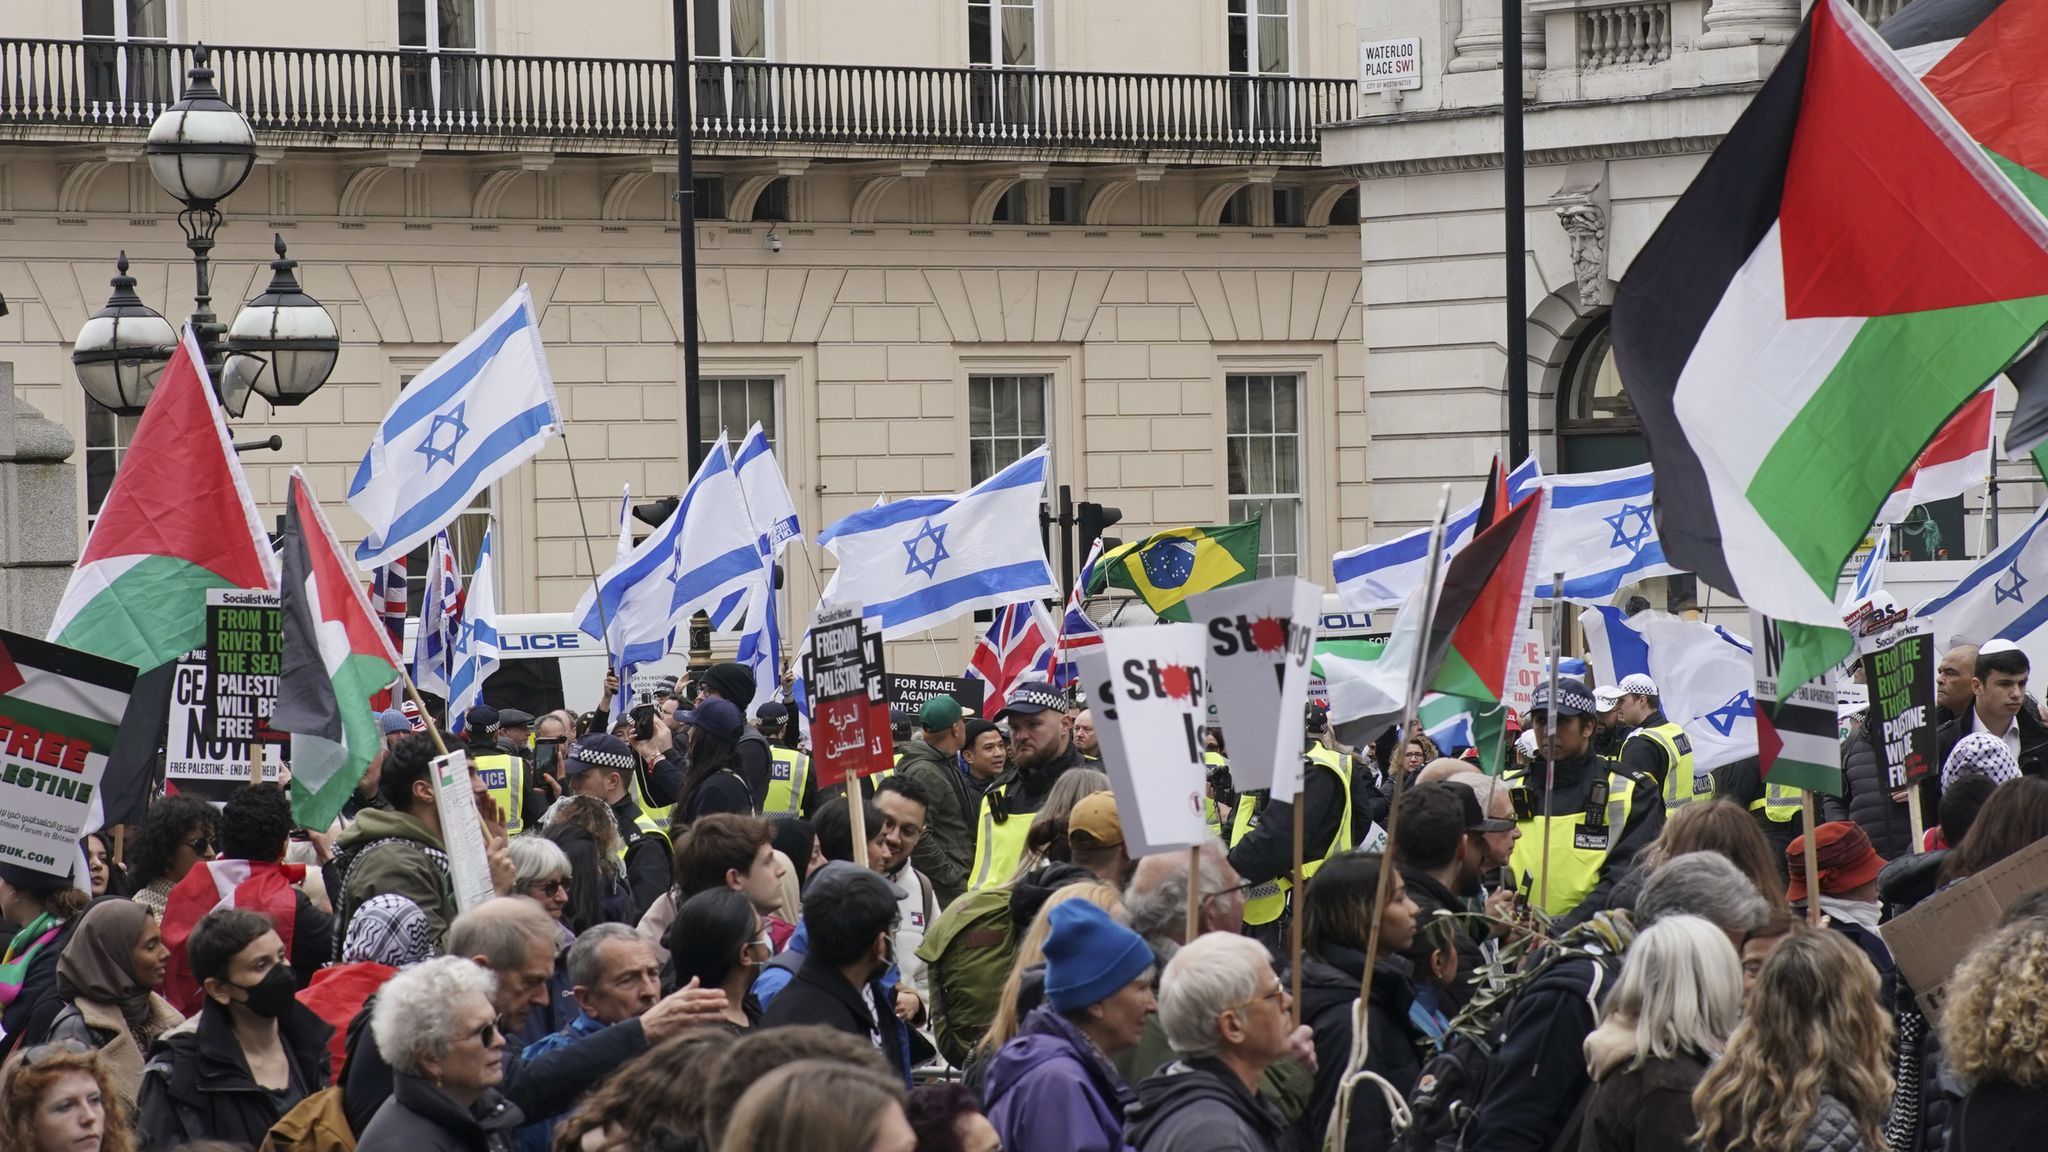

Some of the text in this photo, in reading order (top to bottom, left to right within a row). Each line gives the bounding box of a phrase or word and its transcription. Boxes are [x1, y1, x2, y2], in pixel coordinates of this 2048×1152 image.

[1366, 44, 1413, 60] WATERLOO
[1366, 59, 1414, 76] PLACE SW1
[1383, 80, 1412, 88] WESTMINSTER
[223, 593, 261, 605] Socialist
[218, 609, 261, 630] FROM
[1318, 613, 1372, 630] OLI
[218, 630, 284, 653] RIVER TO
[499, 633, 580, 651] LICE
[816, 624, 858, 659] FREEDOM
[1900, 638, 1921, 663] THE
[217, 652, 280, 675] THE SEA
[217, 674, 281, 696] PALESTI
[816, 663, 865, 698] PALESTINE
[894, 678, 917, 689] FOR
[920, 680, 957, 692] ISRAEL
[1123, 659, 1203, 707] Stp
[1902, 663, 1914, 686] TO
[900, 691, 950, 702] AGAIN
[1756, 680, 1769, 695] FREE
[217, 696, 253, 717] WILL
[216, 717, 253, 739] FREE
[170, 762, 187, 774] FREE
[188, 762, 225, 776] PALESTINE
[230, 764, 243, 776] END
[0, 761, 93, 804] ESTINE
[21, 824, 43, 836] Forum
[52, 831, 76, 845] Britain
